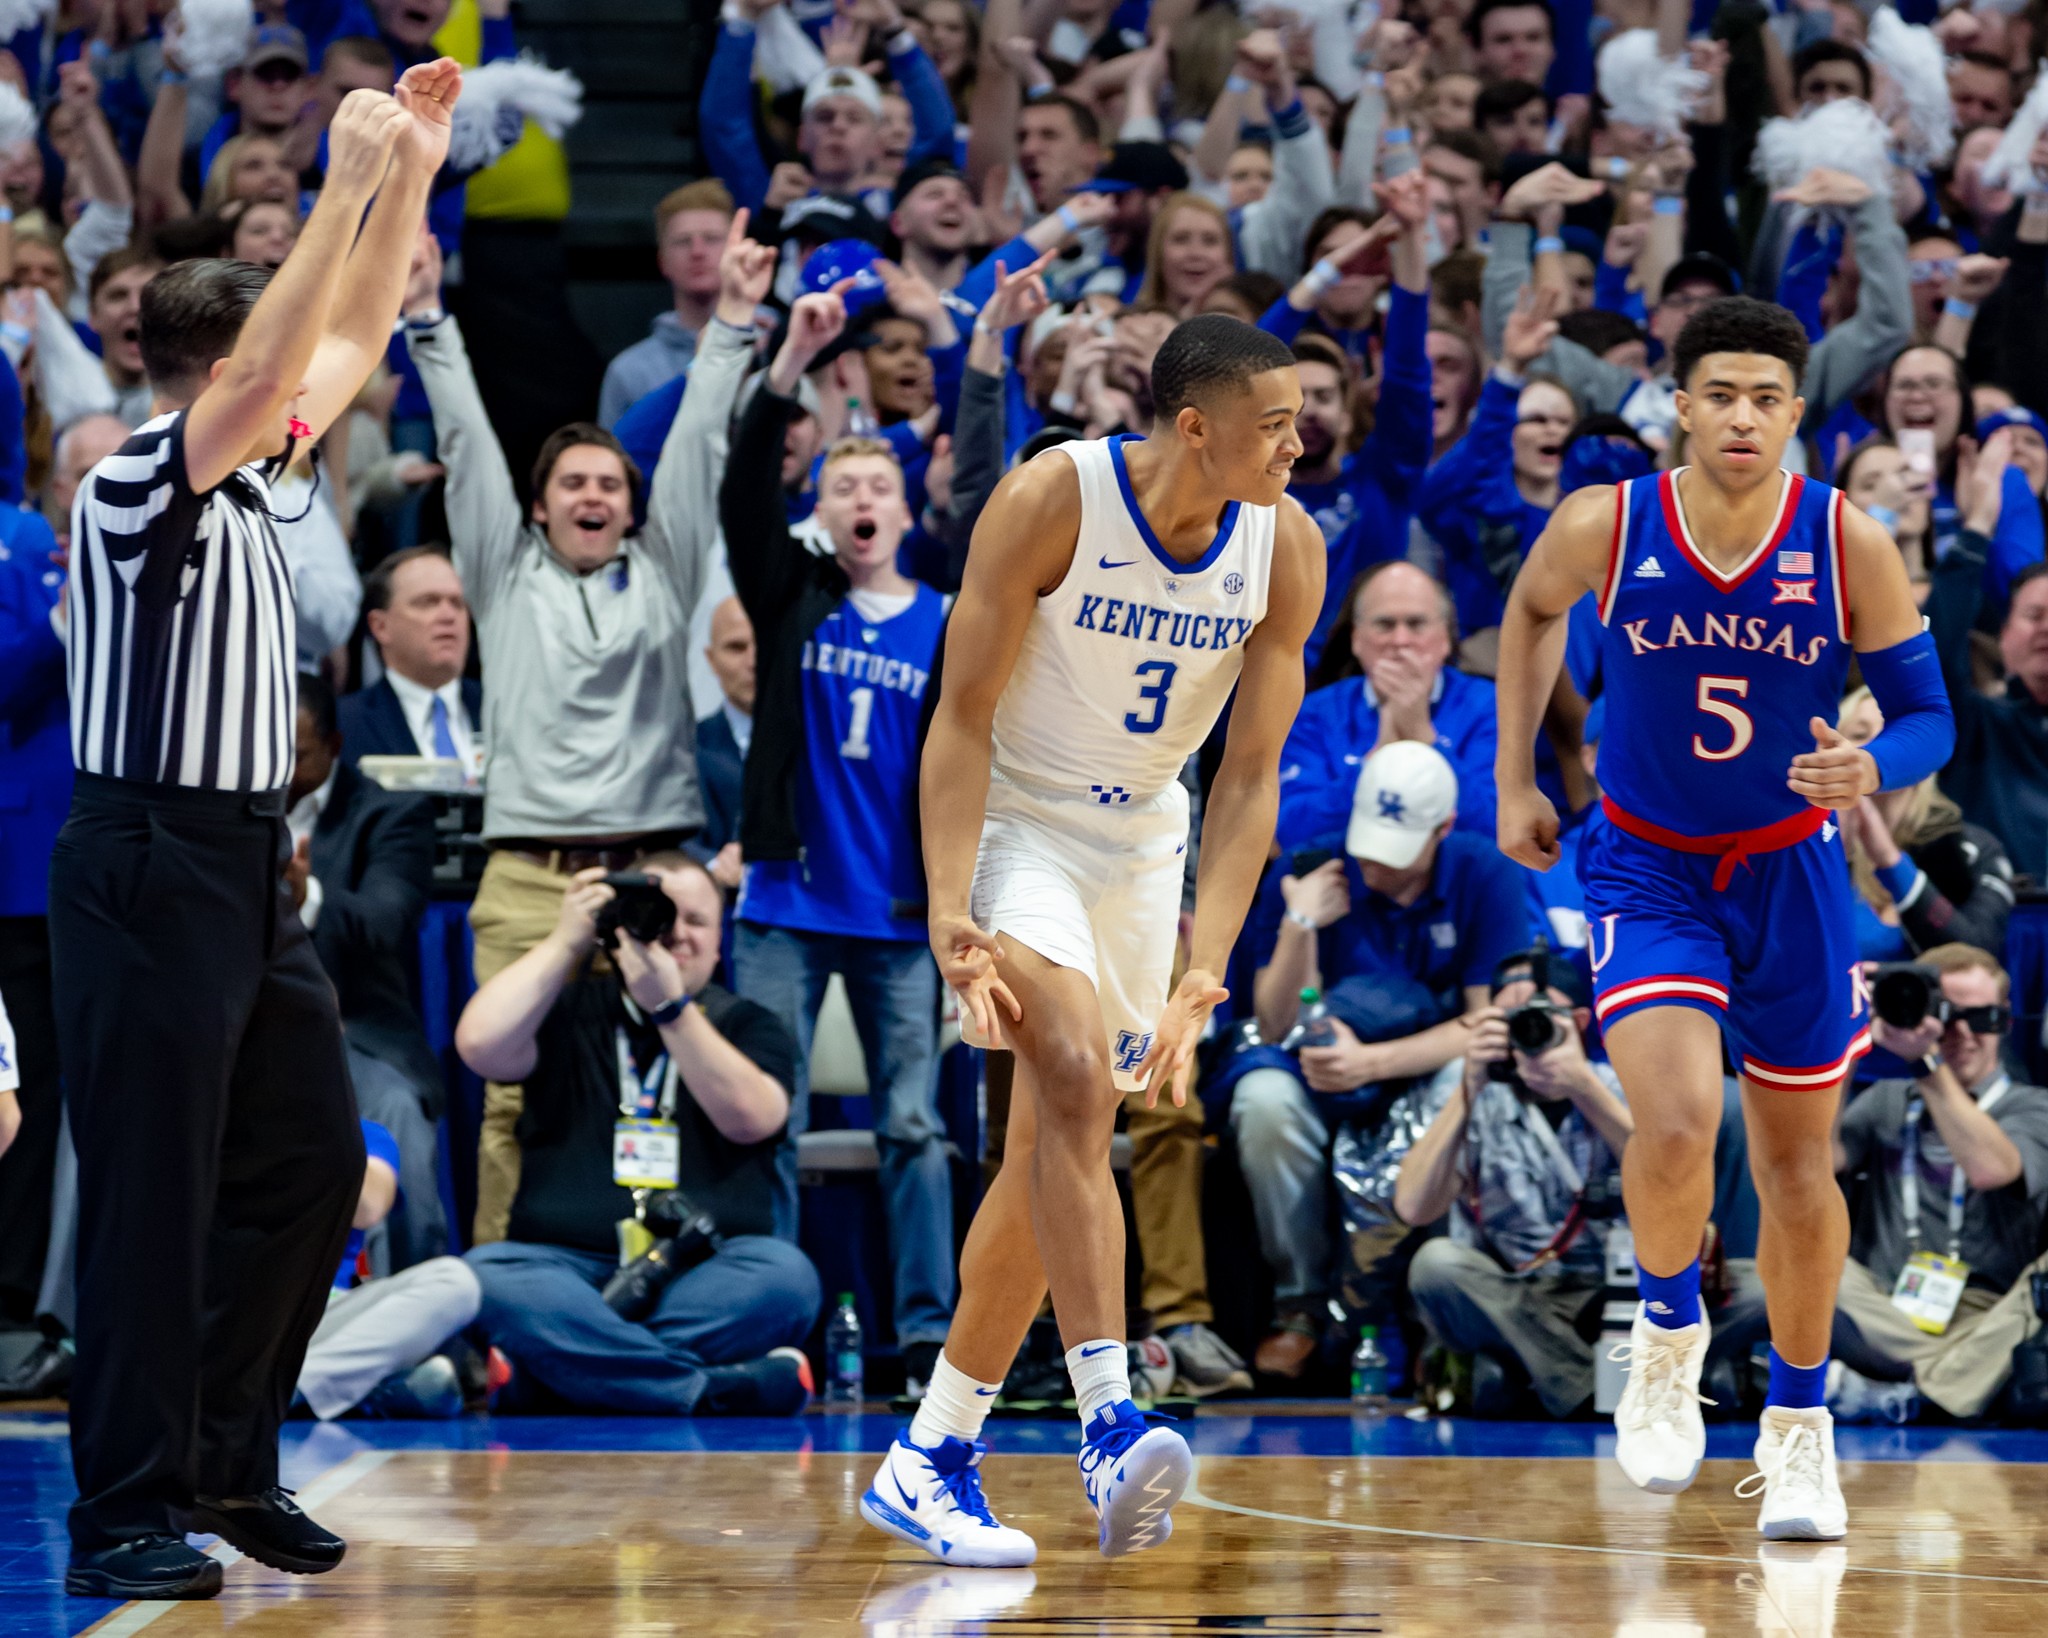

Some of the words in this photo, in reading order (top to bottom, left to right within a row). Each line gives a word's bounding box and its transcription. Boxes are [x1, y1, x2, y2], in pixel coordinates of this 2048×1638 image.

[1224, 573, 1244, 594] SEC
[1074, 594, 1253, 650] KENTUCKY
[1621, 611, 1829, 666] KANSAS
[840, 686, 874, 761] 1
[1123, 660, 1179, 734] 3
[1691, 673, 1755, 762] 5
